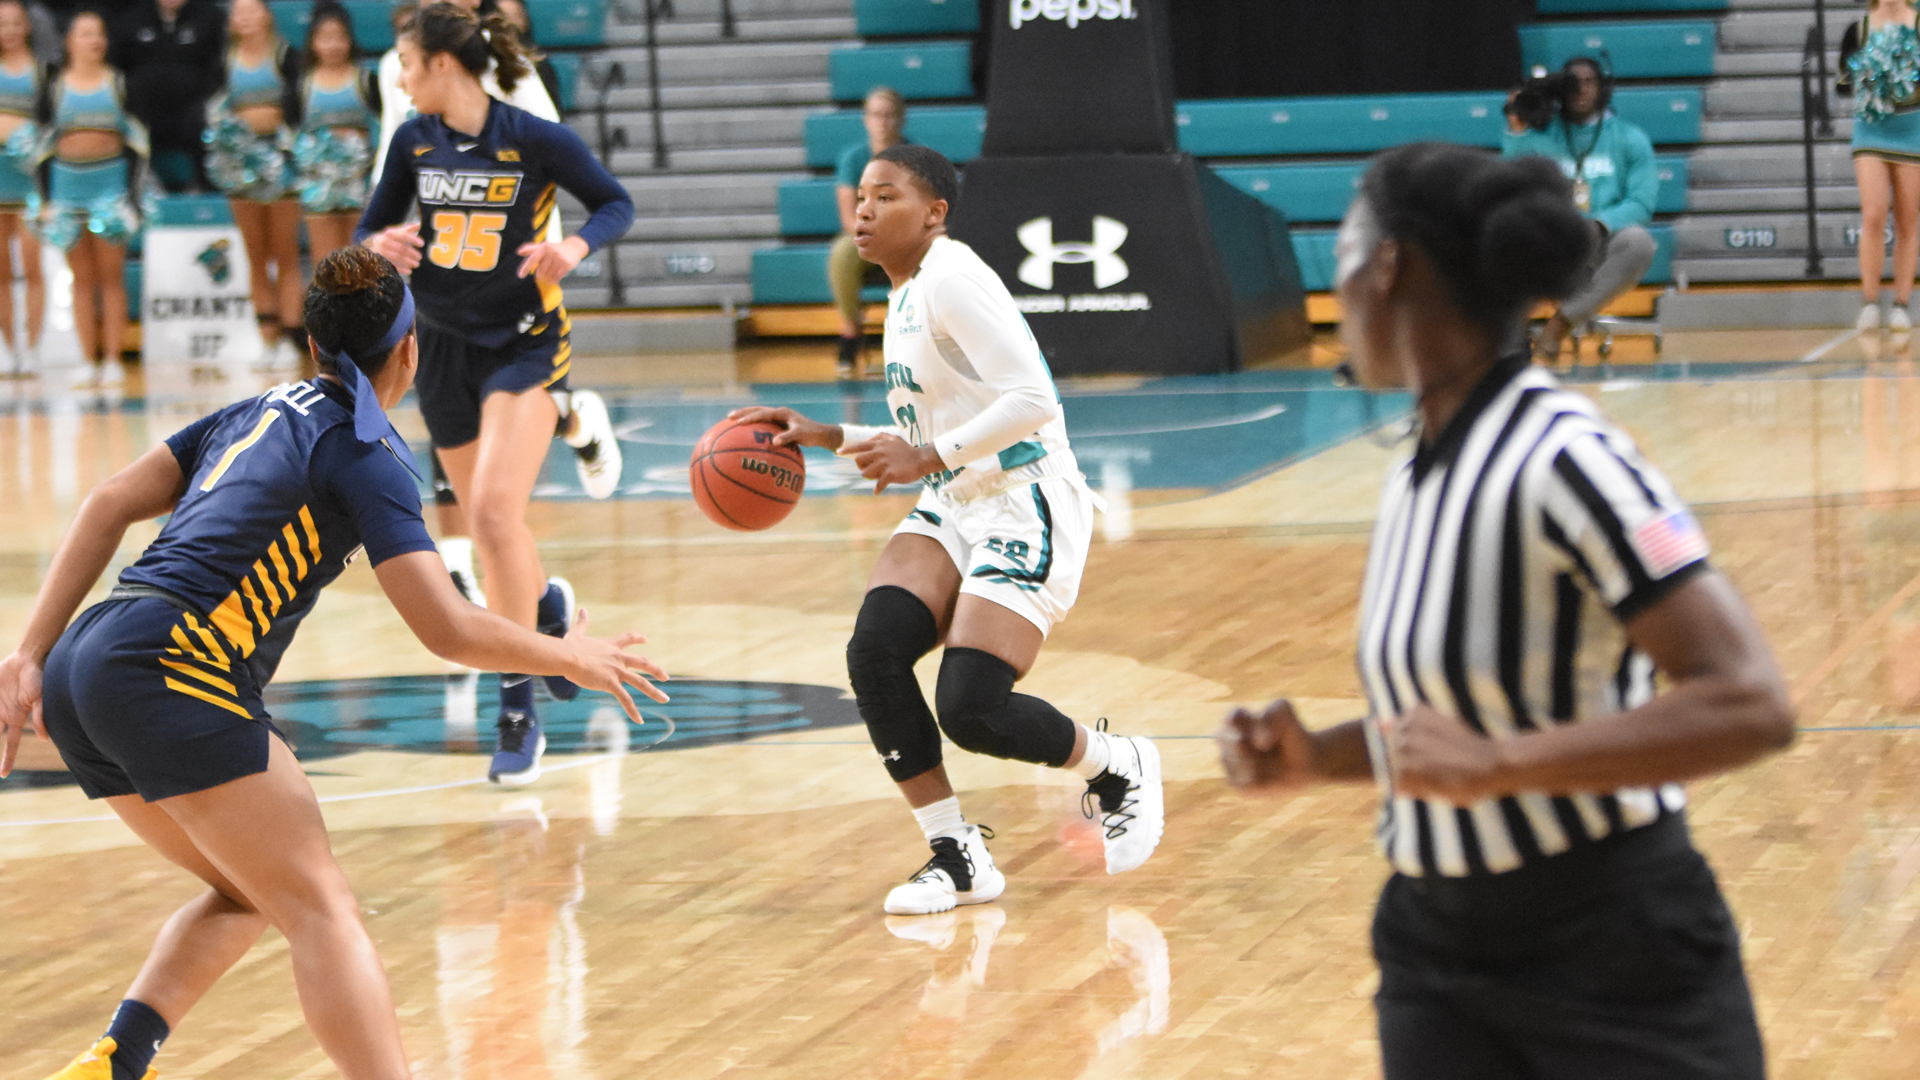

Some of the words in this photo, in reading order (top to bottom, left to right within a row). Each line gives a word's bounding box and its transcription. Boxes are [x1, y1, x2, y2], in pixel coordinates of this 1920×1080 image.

[419, 174, 520, 203] UNCG
[429, 212, 507, 271] 35
[1012, 294, 1066, 313] NDER
[200, 408, 281, 493] 1
[741, 456, 804, 494] Wilson
